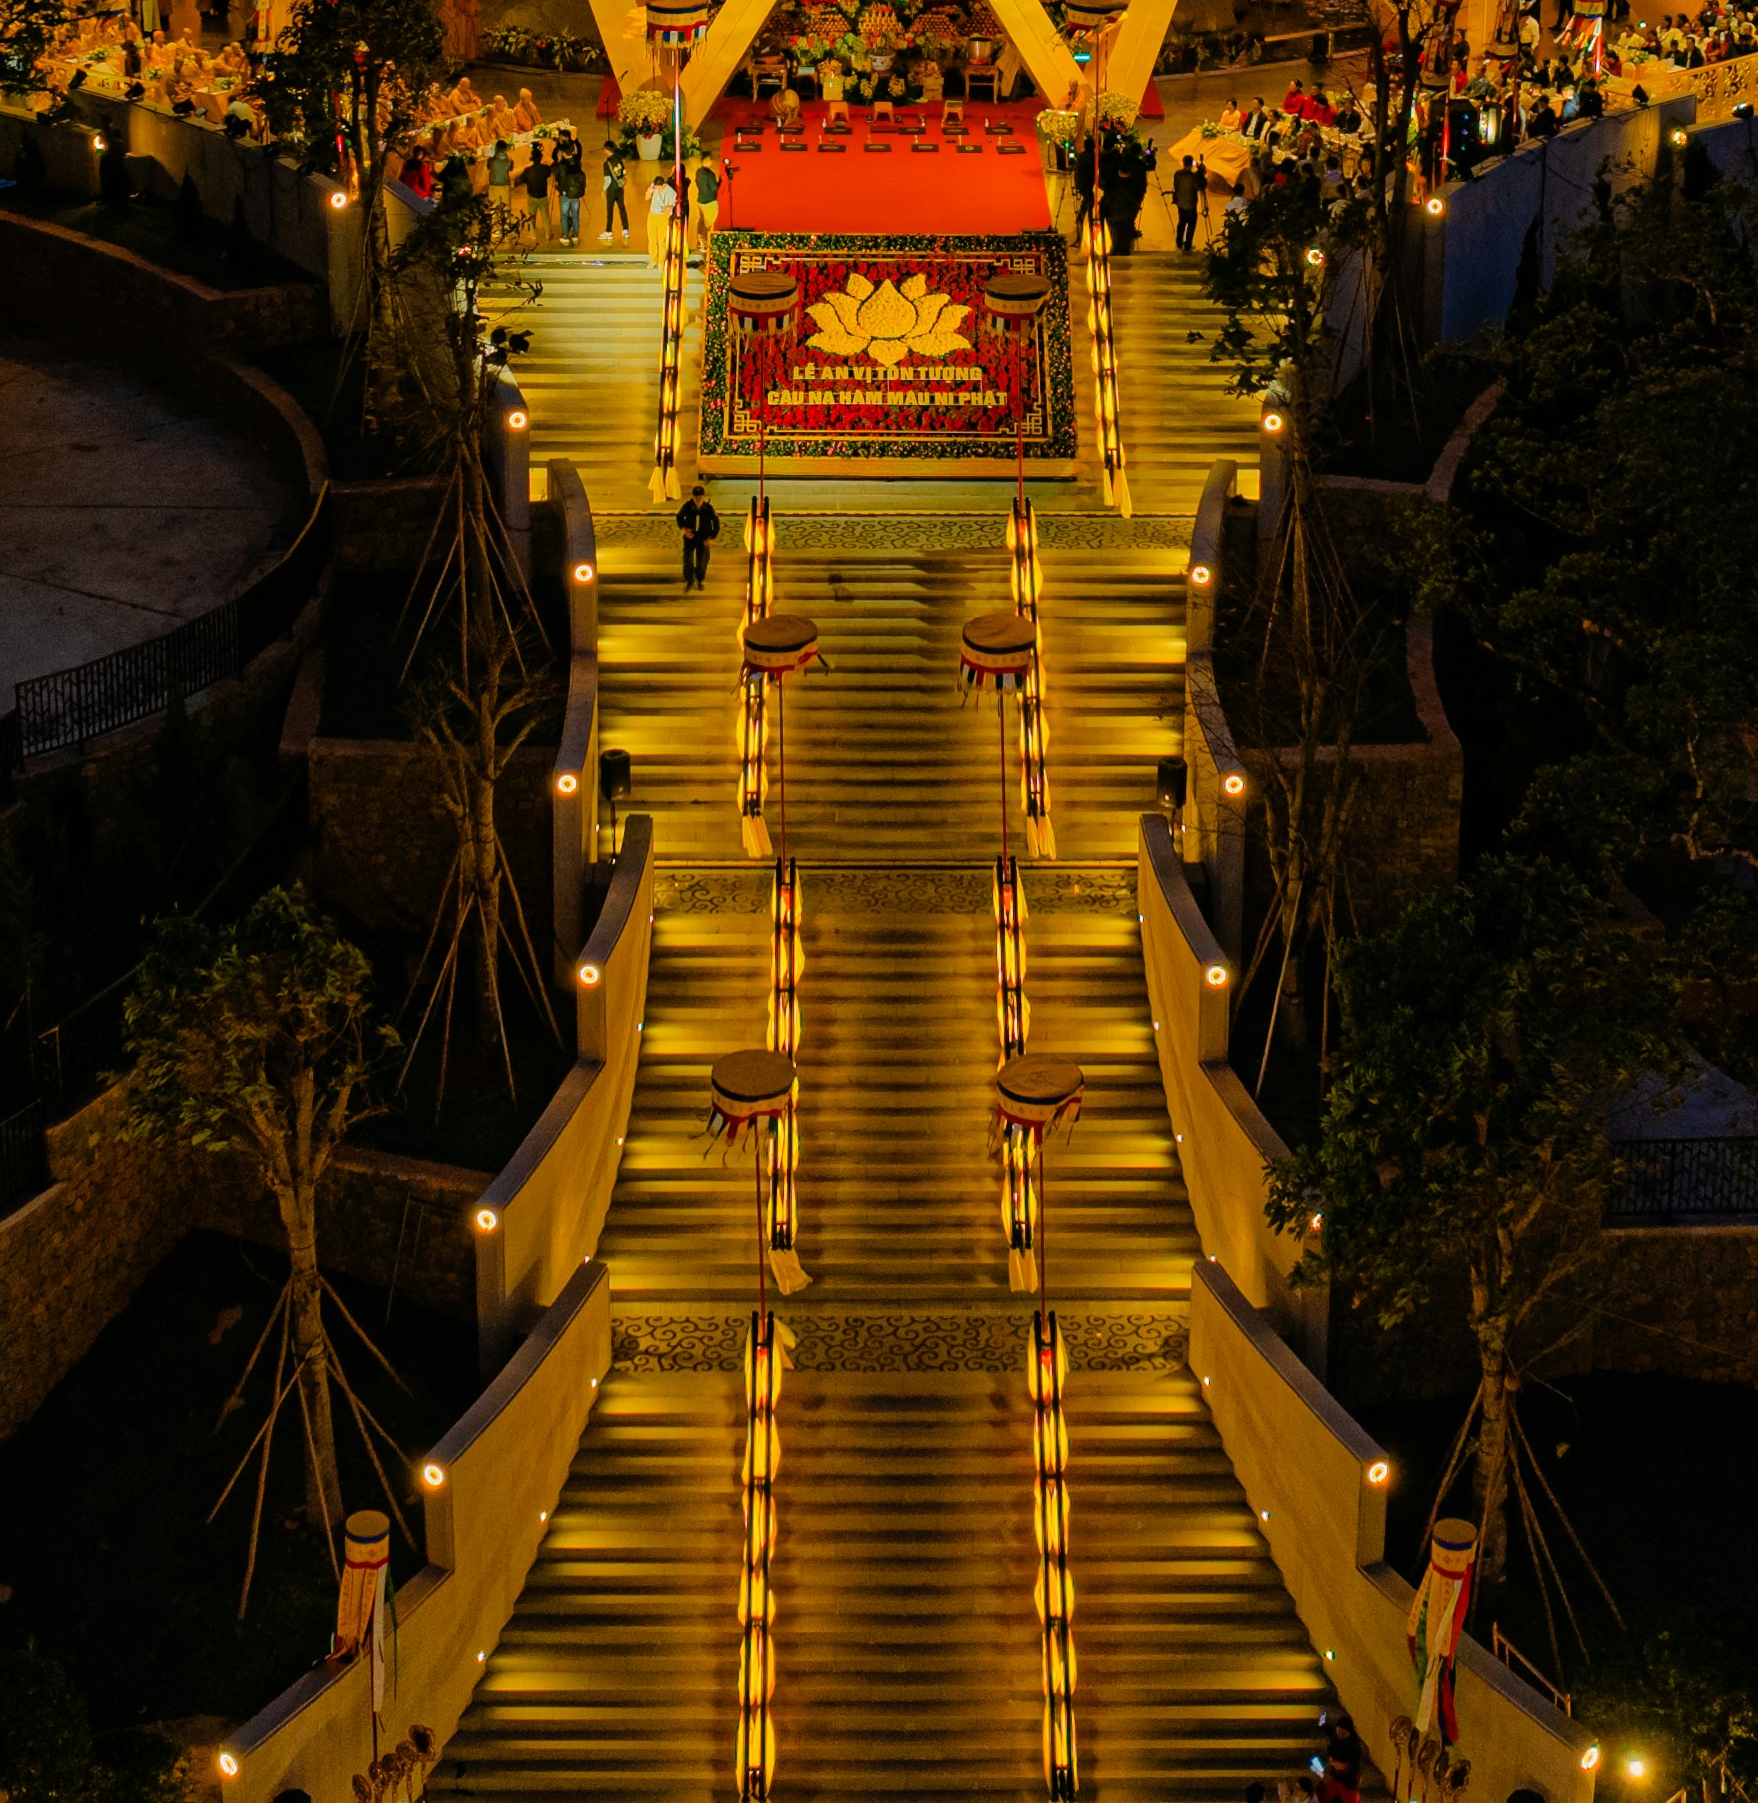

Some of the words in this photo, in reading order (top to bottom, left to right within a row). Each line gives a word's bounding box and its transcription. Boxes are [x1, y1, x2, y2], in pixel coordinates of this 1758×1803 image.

[821, 366, 849, 380] AN
[852, 366, 872, 384] VỊ
[876, 364, 914, 380] TÔN
[917, 365, 983, 384] TƯỢNG
[767, 389, 804, 405] CÂU
[808, 391, 835, 405] NA
[887, 390, 930, 405] MÂU
[934, 391, 954, 405] NI
[958, 390, 1008, 409] PHẬT
